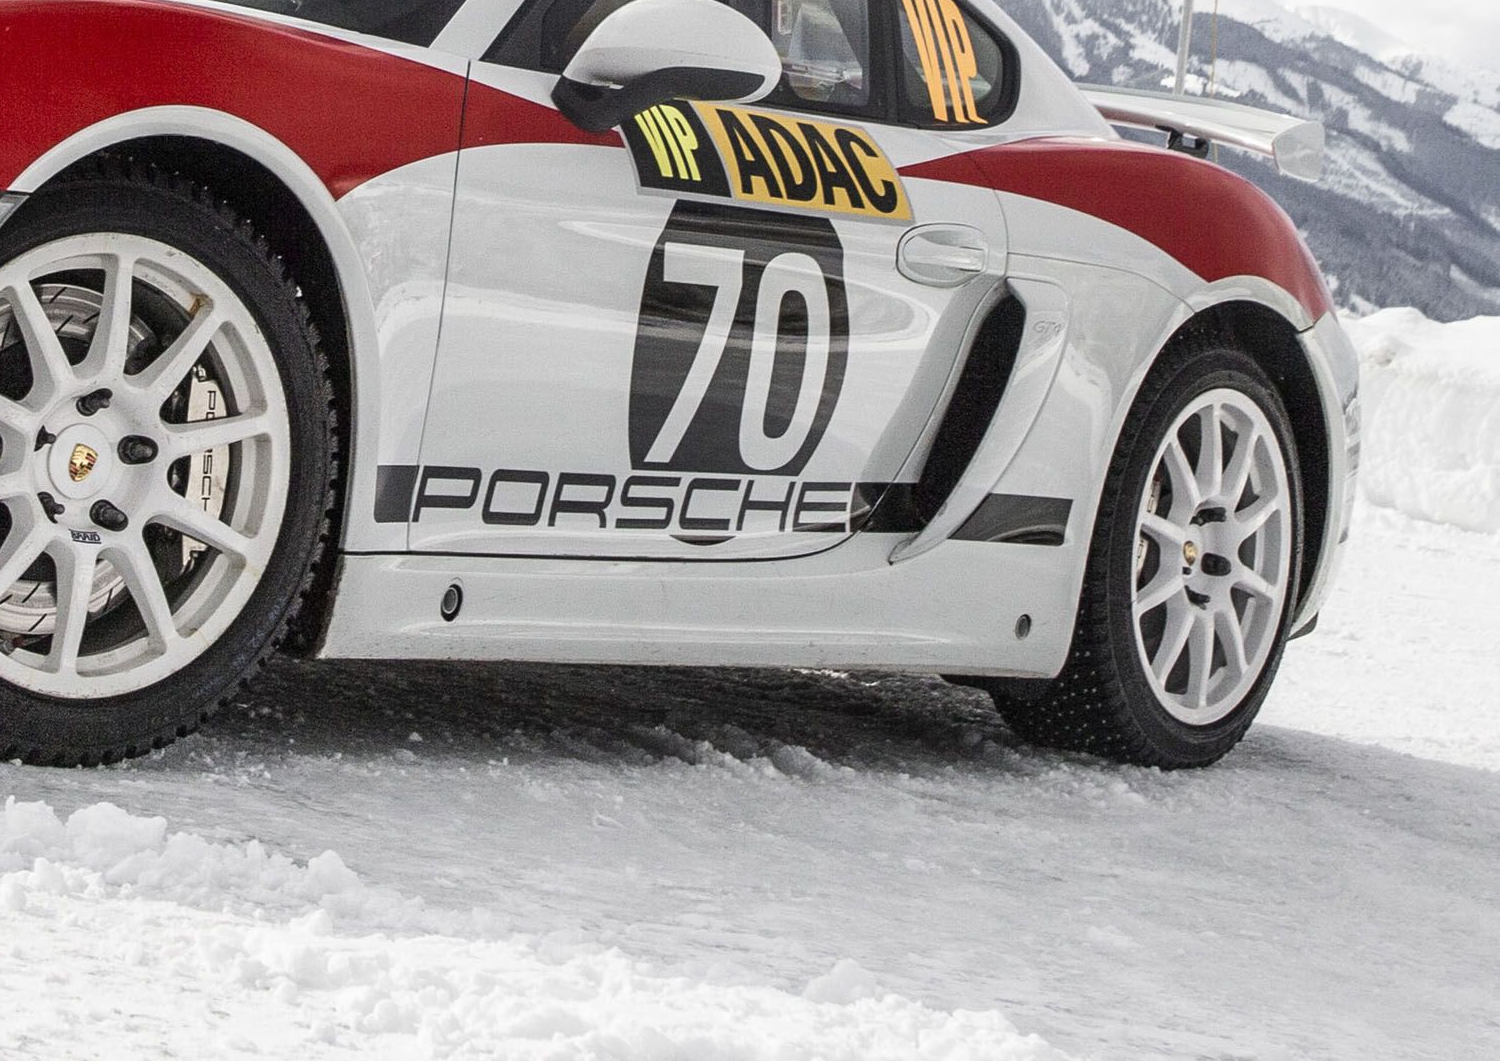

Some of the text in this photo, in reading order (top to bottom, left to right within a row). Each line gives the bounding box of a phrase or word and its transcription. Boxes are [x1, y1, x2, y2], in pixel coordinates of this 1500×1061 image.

[634, 103, 898, 214] VIP ADAC
[643, 241, 830, 472] 70
[412, 466, 852, 532] PORSCHE
